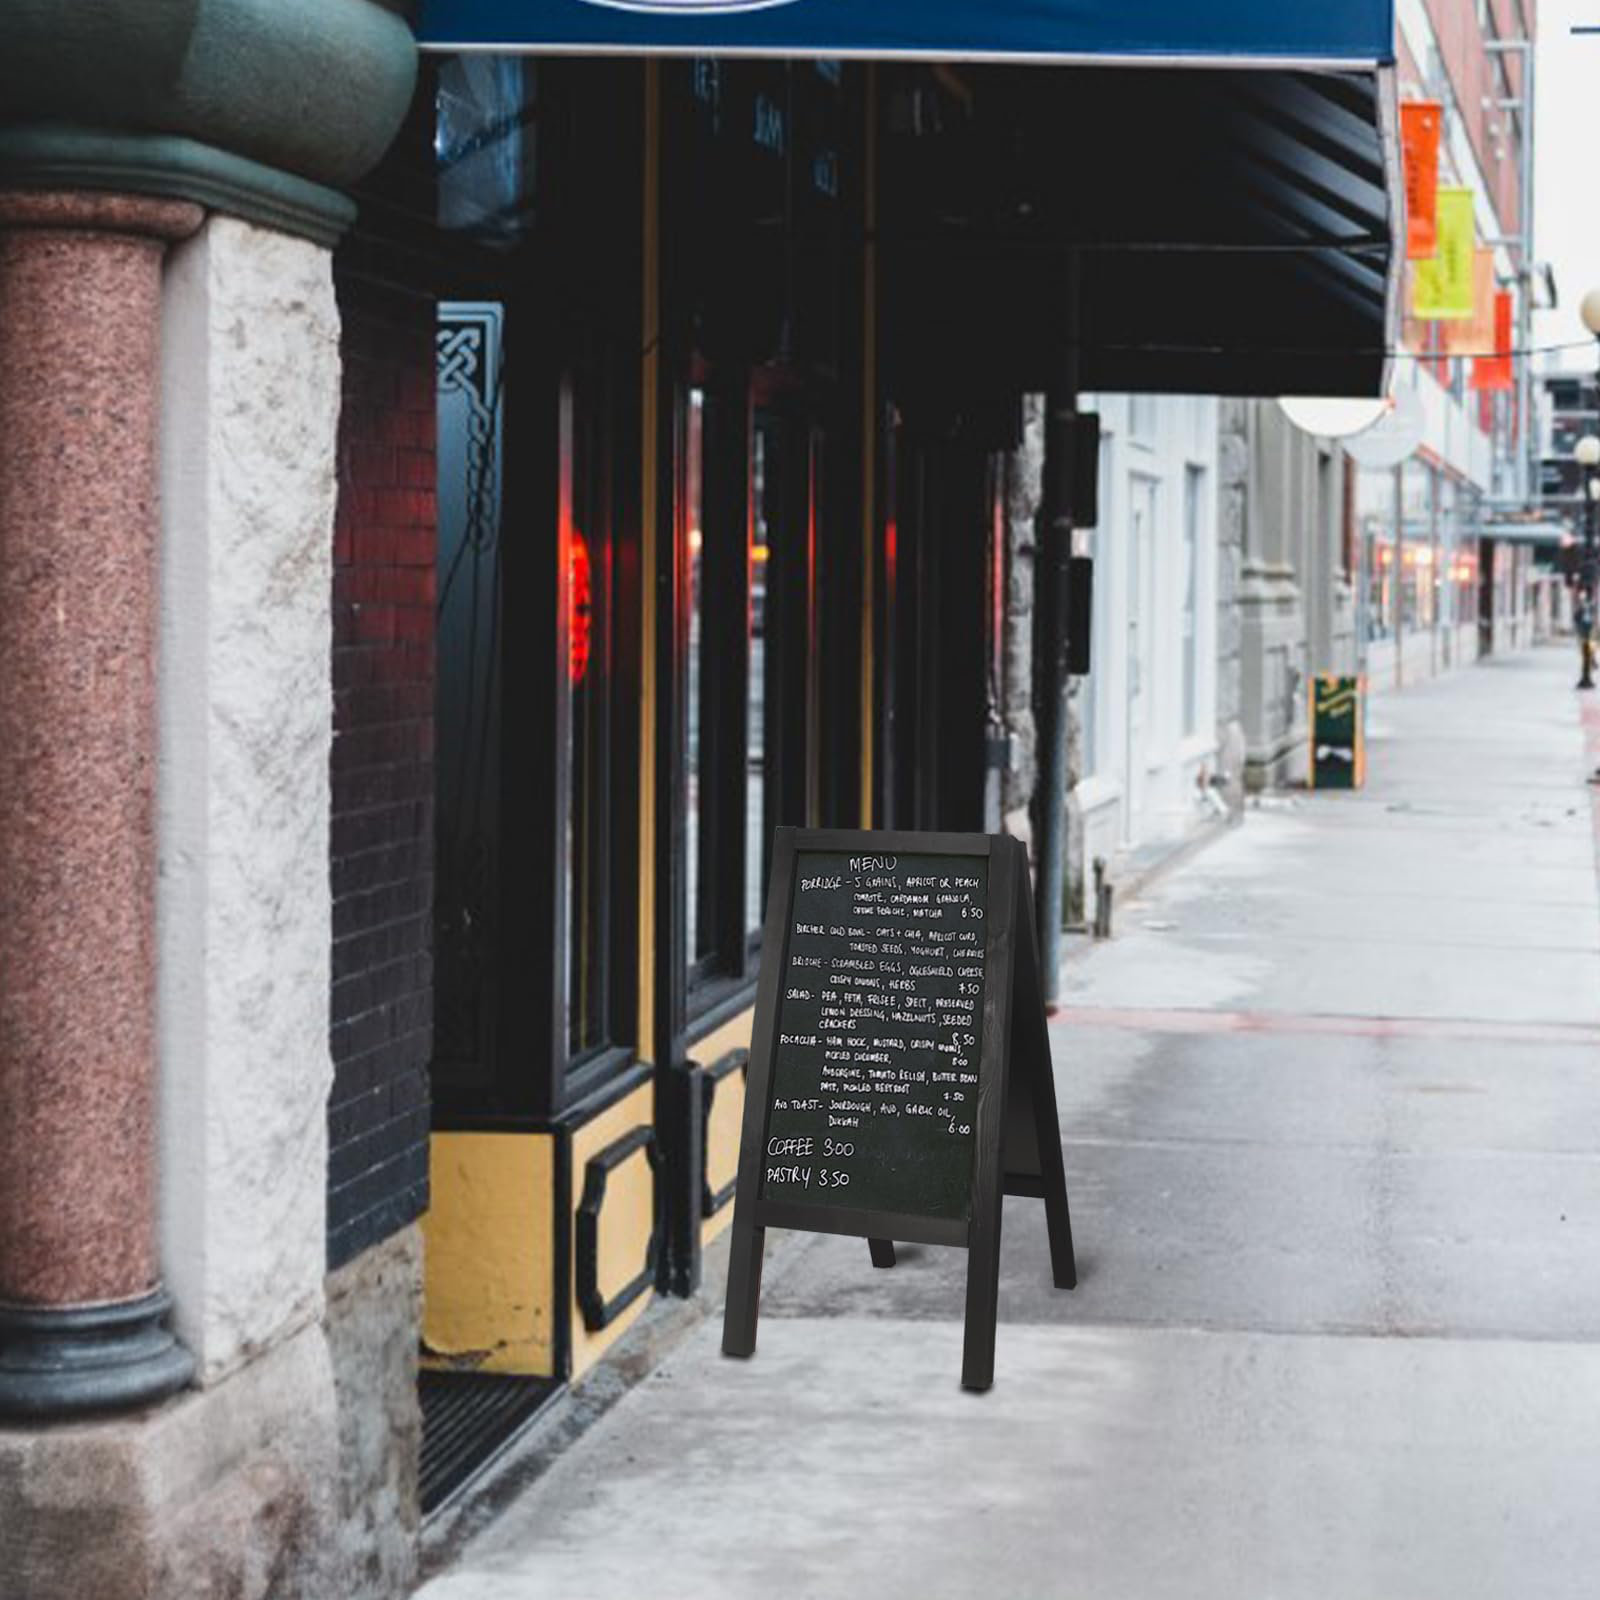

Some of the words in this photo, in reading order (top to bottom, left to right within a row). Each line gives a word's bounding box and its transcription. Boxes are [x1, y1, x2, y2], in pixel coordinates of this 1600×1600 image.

[850, 855, 898, 873] MENU
[801, 876, 842, 892] PORRIDGE
[854, 877, 861, 888] 5
[906, 877, 937, 888] APRICOT
[940, 877, 951, 889] OR
[955, 877, 979, 889] PEACH
[890, 894, 929, 905] CARDAMOM
[913, 908, 943, 918] MATCHA
[796, 923, 825, 935] BIRCHER
[830, 926, 846, 937] COLD
[875, 927, 895, 938] OATS
[928, 930, 957, 942] APRICOT
[849, 943, 878, 954] TOASTED
[792, 956, 822, 969] BRIOCHE
[831, 958, 876, 971] SCRAMBLED
[829, 974, 852, 985] CRISPY
[889, 979, 917, 992] HERBS
[821, 1006, 846, 1017] LEMON
[935, 997, 976, 1011] PRESERVED
[818, 1018, 857, 1030] CRACKERS
[826, 1035, 843, 1047] HAM
[910, 1040, 935, 1051] CRISPY
[868, 1069, 897, 1081] TOMATO
[932, 1072, 958, 1083] BUTTER
[959, 1073, 979, 1084] BEAN
[874, 1083, 911, 1095] BEETROOT
[774, 1099, 788, 1111] AVO
[905, 1103, 933, 1116] GARLIC
[767, 1137, 815, 1157] COFFEE
[766, 1166, 812, 1189] PASTRY
[818, 1169, 850, 1188] 3.50
